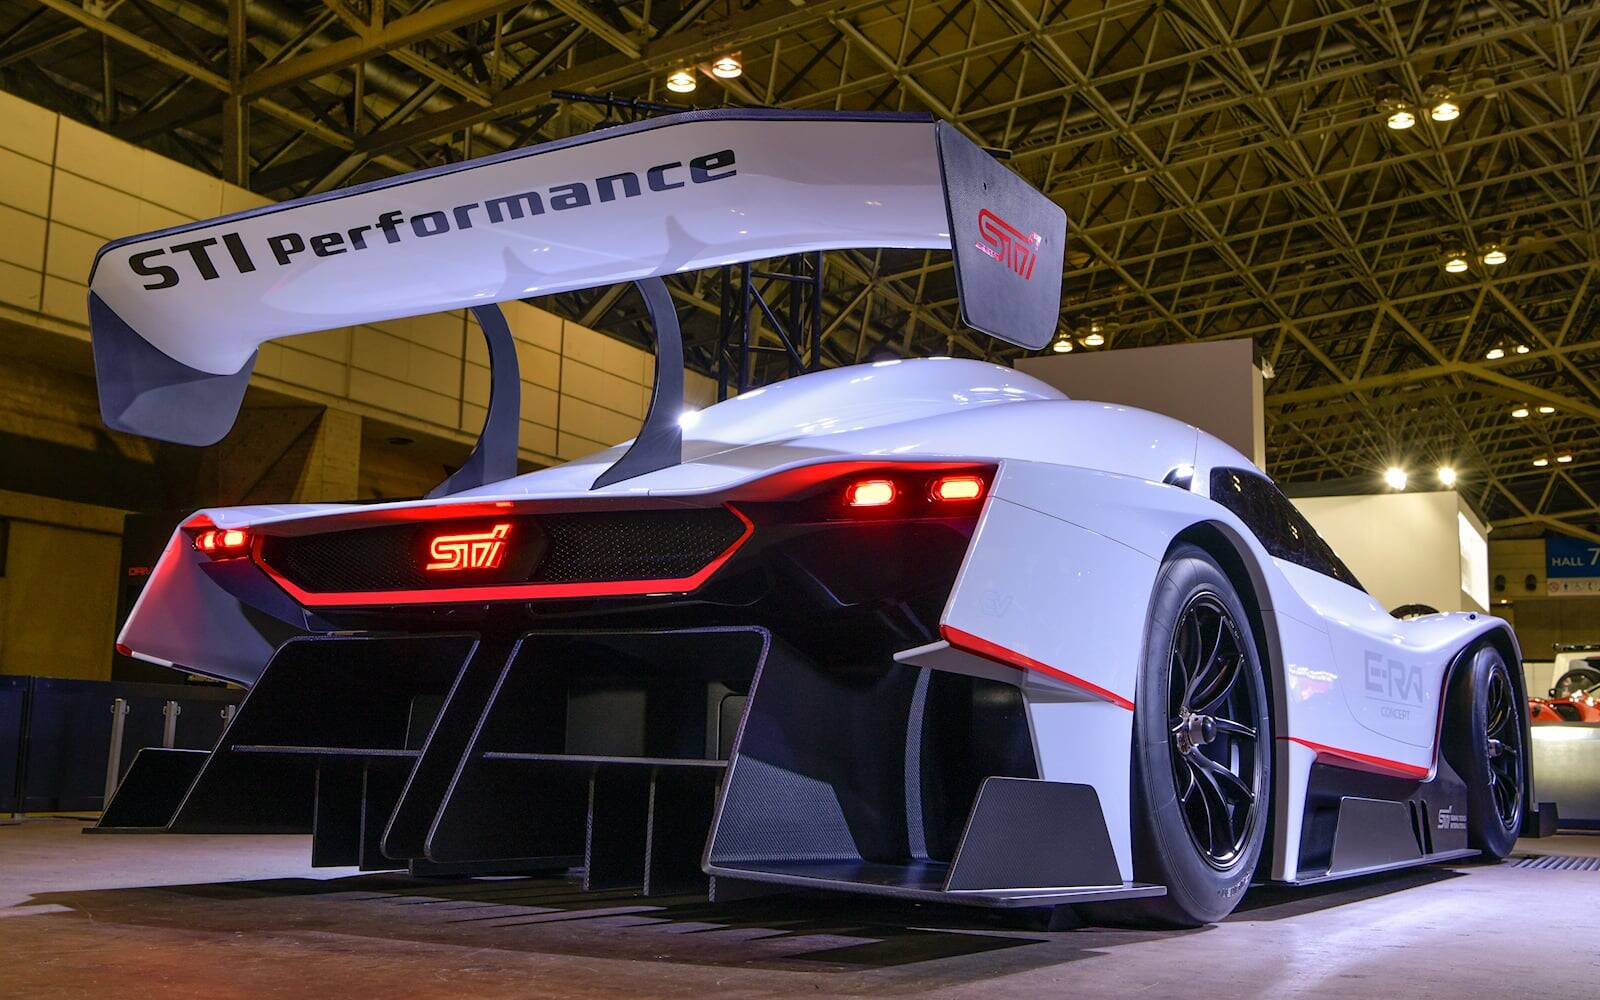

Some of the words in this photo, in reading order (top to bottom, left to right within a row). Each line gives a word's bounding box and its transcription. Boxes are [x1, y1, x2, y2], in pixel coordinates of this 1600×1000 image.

[128, 232, 256, 290] STI
[267, 149, 737, 265] Performance
[1551, 556, 1585, 567] HALL
[1587, 547, 1600, 566] 7
[1365, 649, 1423, 703] E-RA
[1381, 705, 1411, 720] CONCEPT
